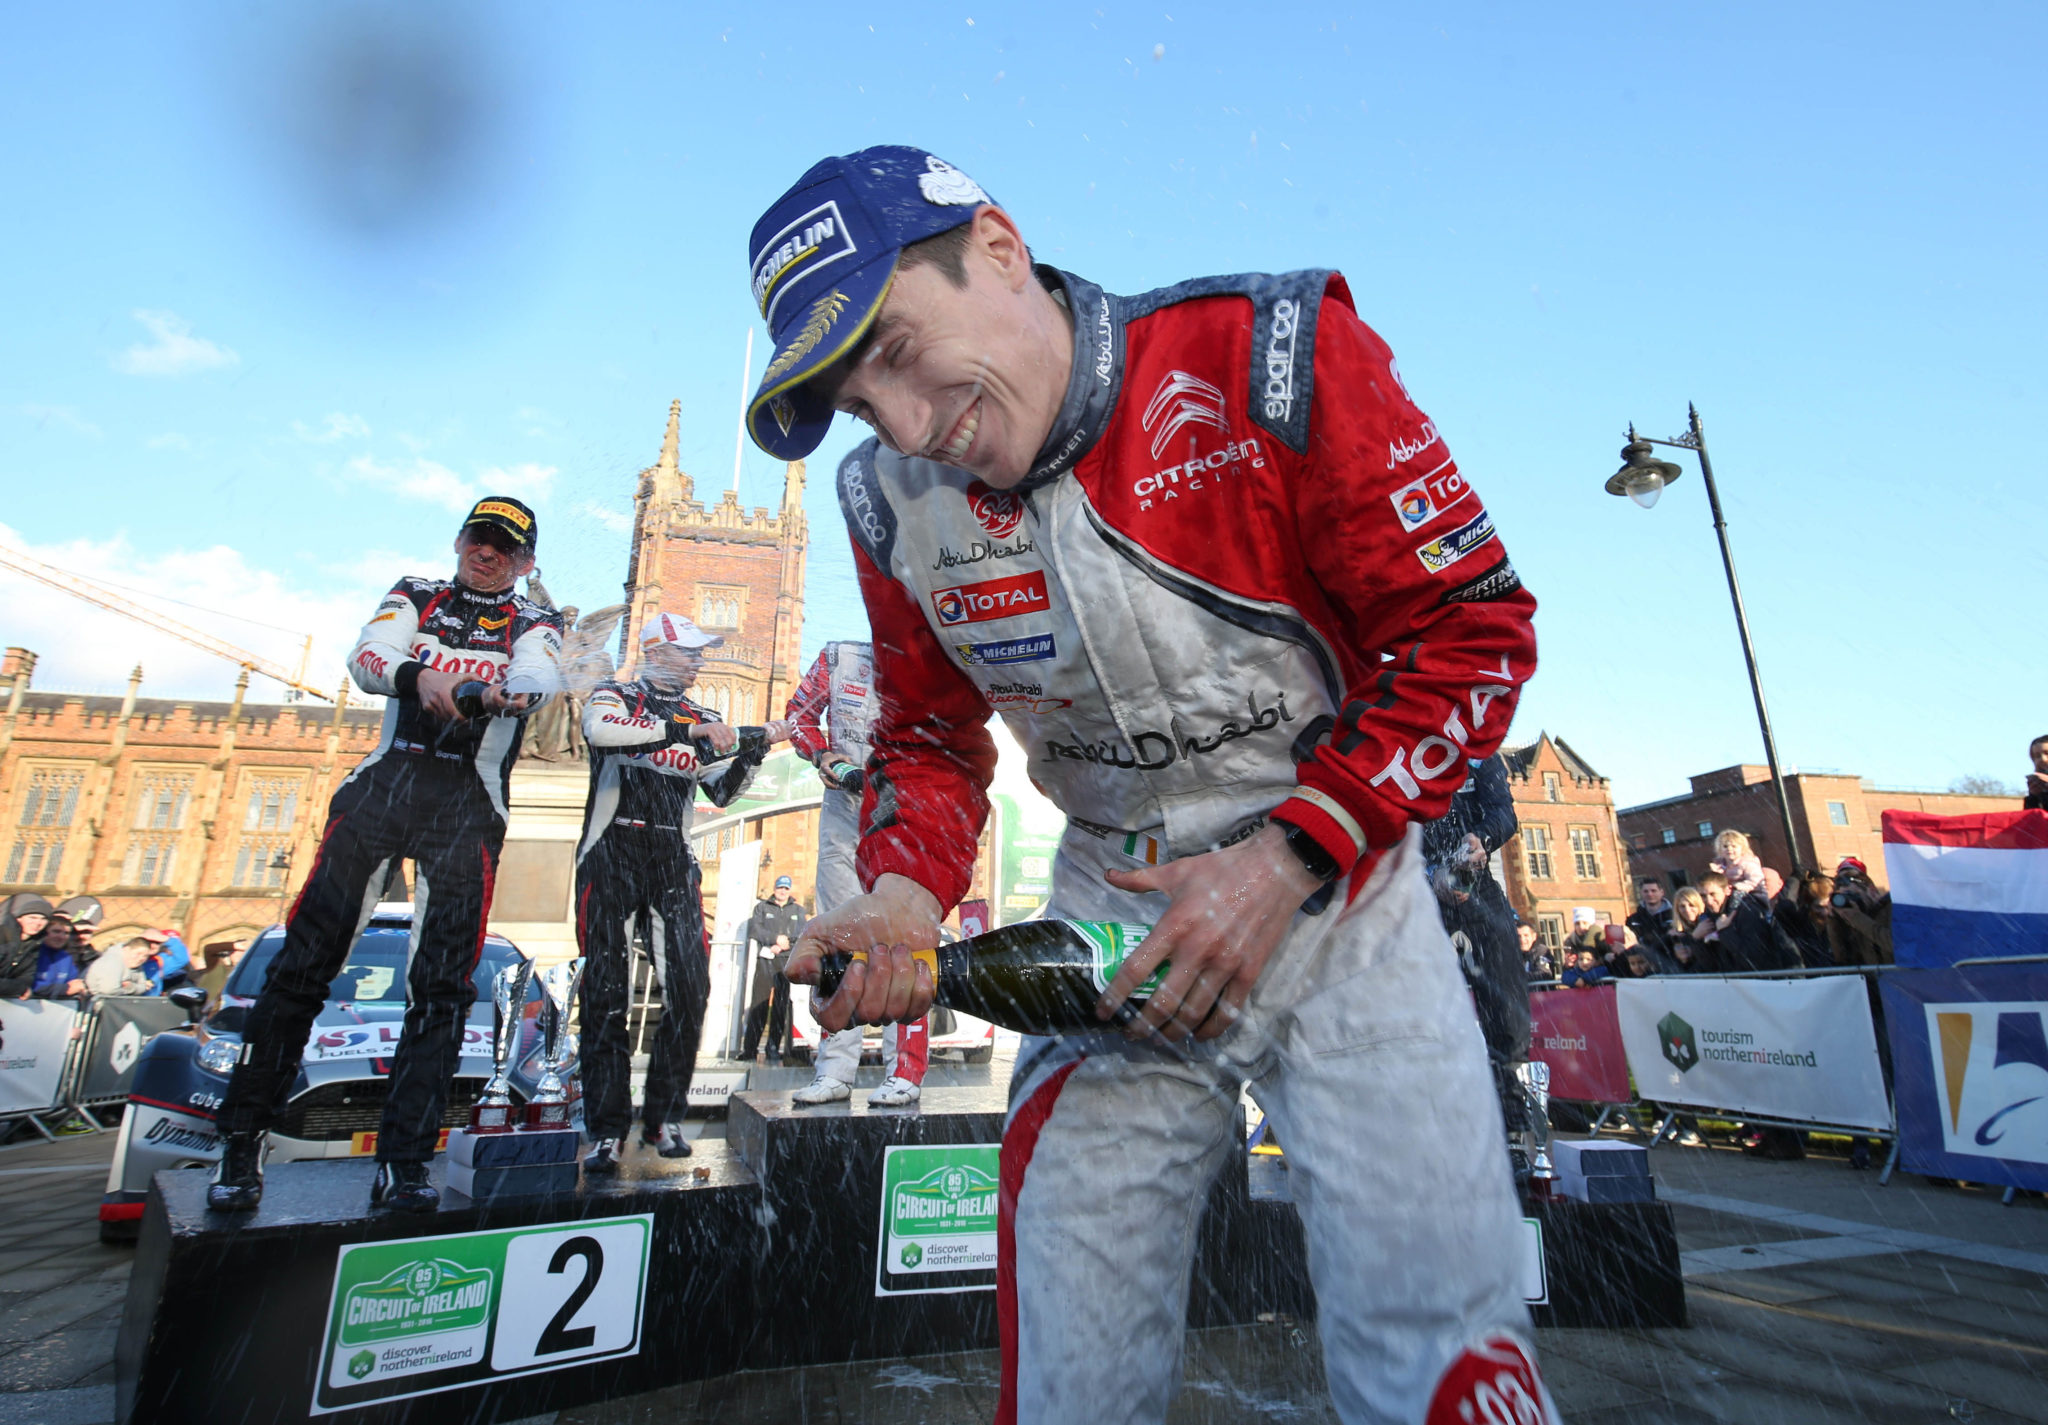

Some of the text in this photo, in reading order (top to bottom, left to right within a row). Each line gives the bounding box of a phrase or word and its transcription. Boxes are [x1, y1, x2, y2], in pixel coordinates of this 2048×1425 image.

[1264, 299, 1300, 423] sparco
[844, 460, 887, 547] sparco
[963, 586, 1044, 613] TOTAL
[983, 638, 1052, 660] MICHELIN
[1369, 652, 1514, 800] TOTAL
[650, 748, 698, 774] OTOS
[1701, 1028, 1754, 1047] tourism
[1703, 1046, 1818, 1069] northernireland
[189, 1090, 223, 1110] cube
[144, 1116, 221, 1152] Dynamic
[896, 1193, 950, 1220] CIRCUIT
[956, 1192, 998, 1217] IRELAN
[927, 1244, 968, 1255] discover
[927, 1251, 998, 1265] northernirelan
[415, 1267, 432, 1283] 85
[347, 1296, 414, 1327] CIRCUIT
[421, 1279, 487, 1316] IRELAND
[534, 1235, 604, 1357] 2
[380, 1346, 473, 1373] northernireland
[382, 1343, 433, 1361] discover
